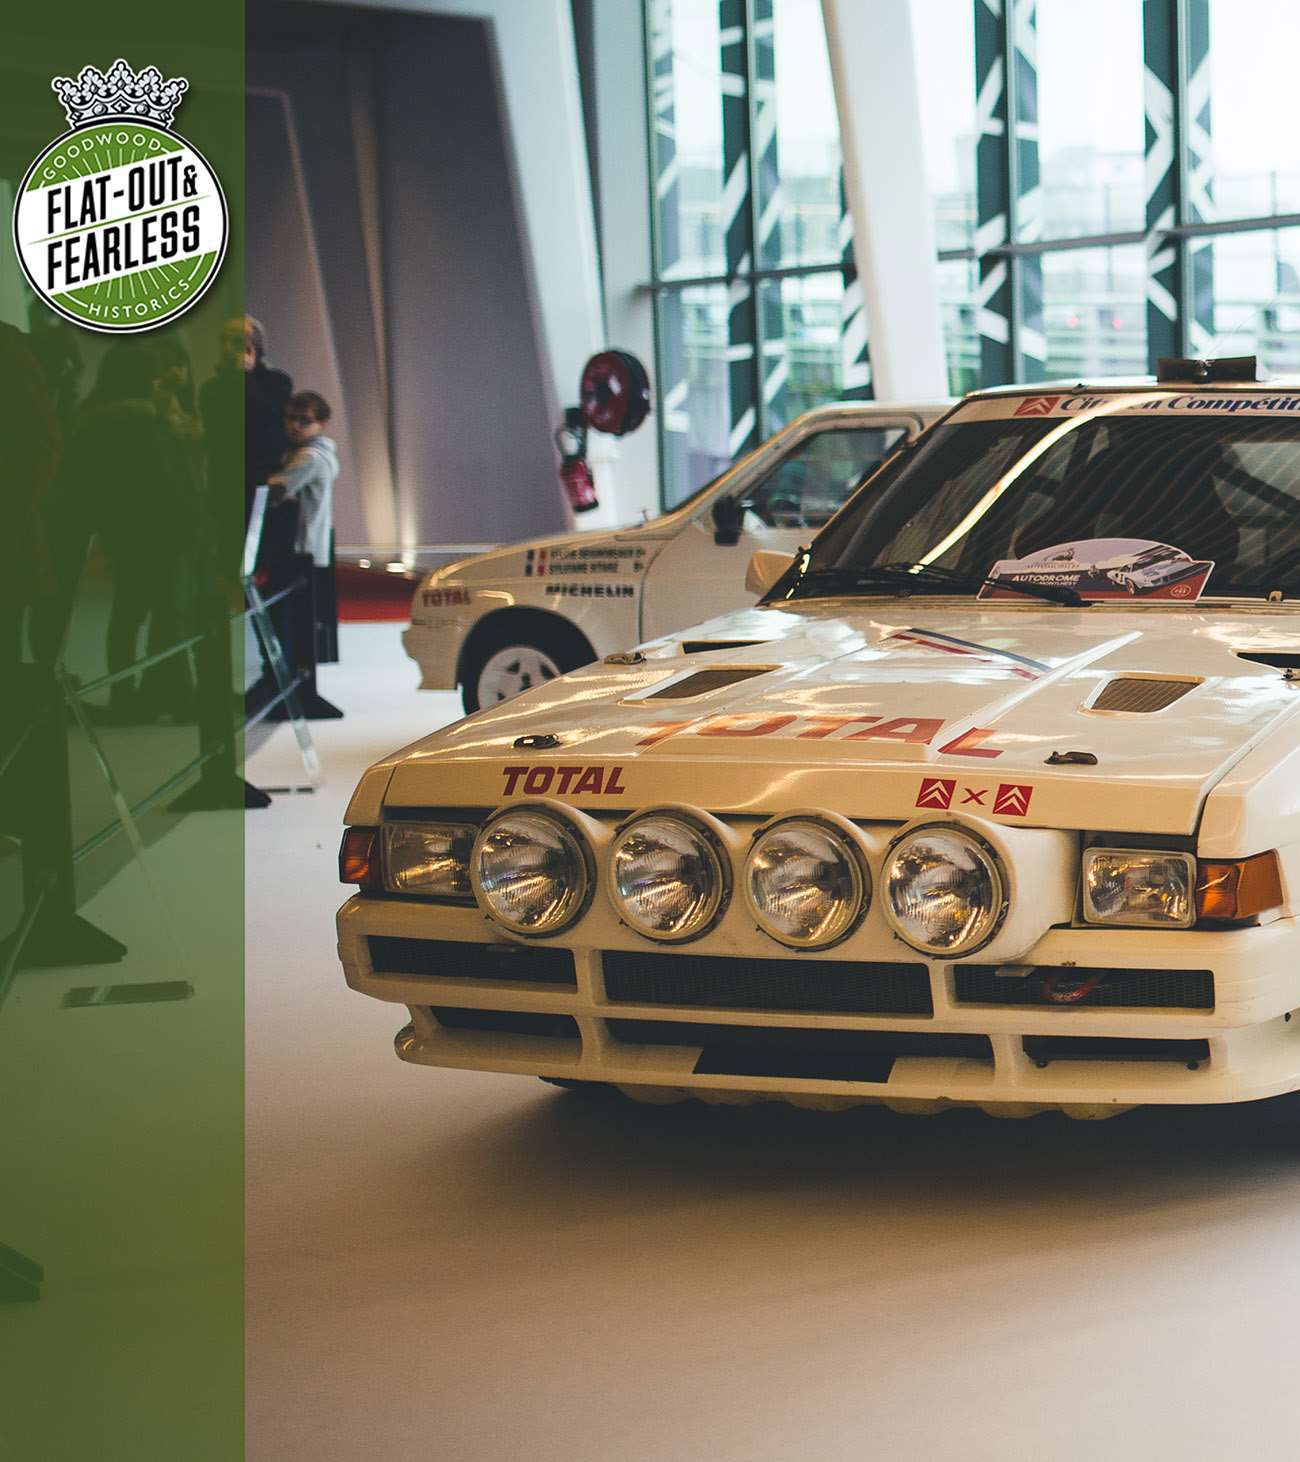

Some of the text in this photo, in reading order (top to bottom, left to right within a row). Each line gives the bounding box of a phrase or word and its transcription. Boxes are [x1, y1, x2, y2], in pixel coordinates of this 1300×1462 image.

[1012, 574, 1080, 582] AUTODROME
[422, 588, 471, 608] TOTAL
[545, 584, 634, 598] MICHELIN
[635, 714, 1005, 759] TOTAL
[502, 766, 626, 796] TOTAL
